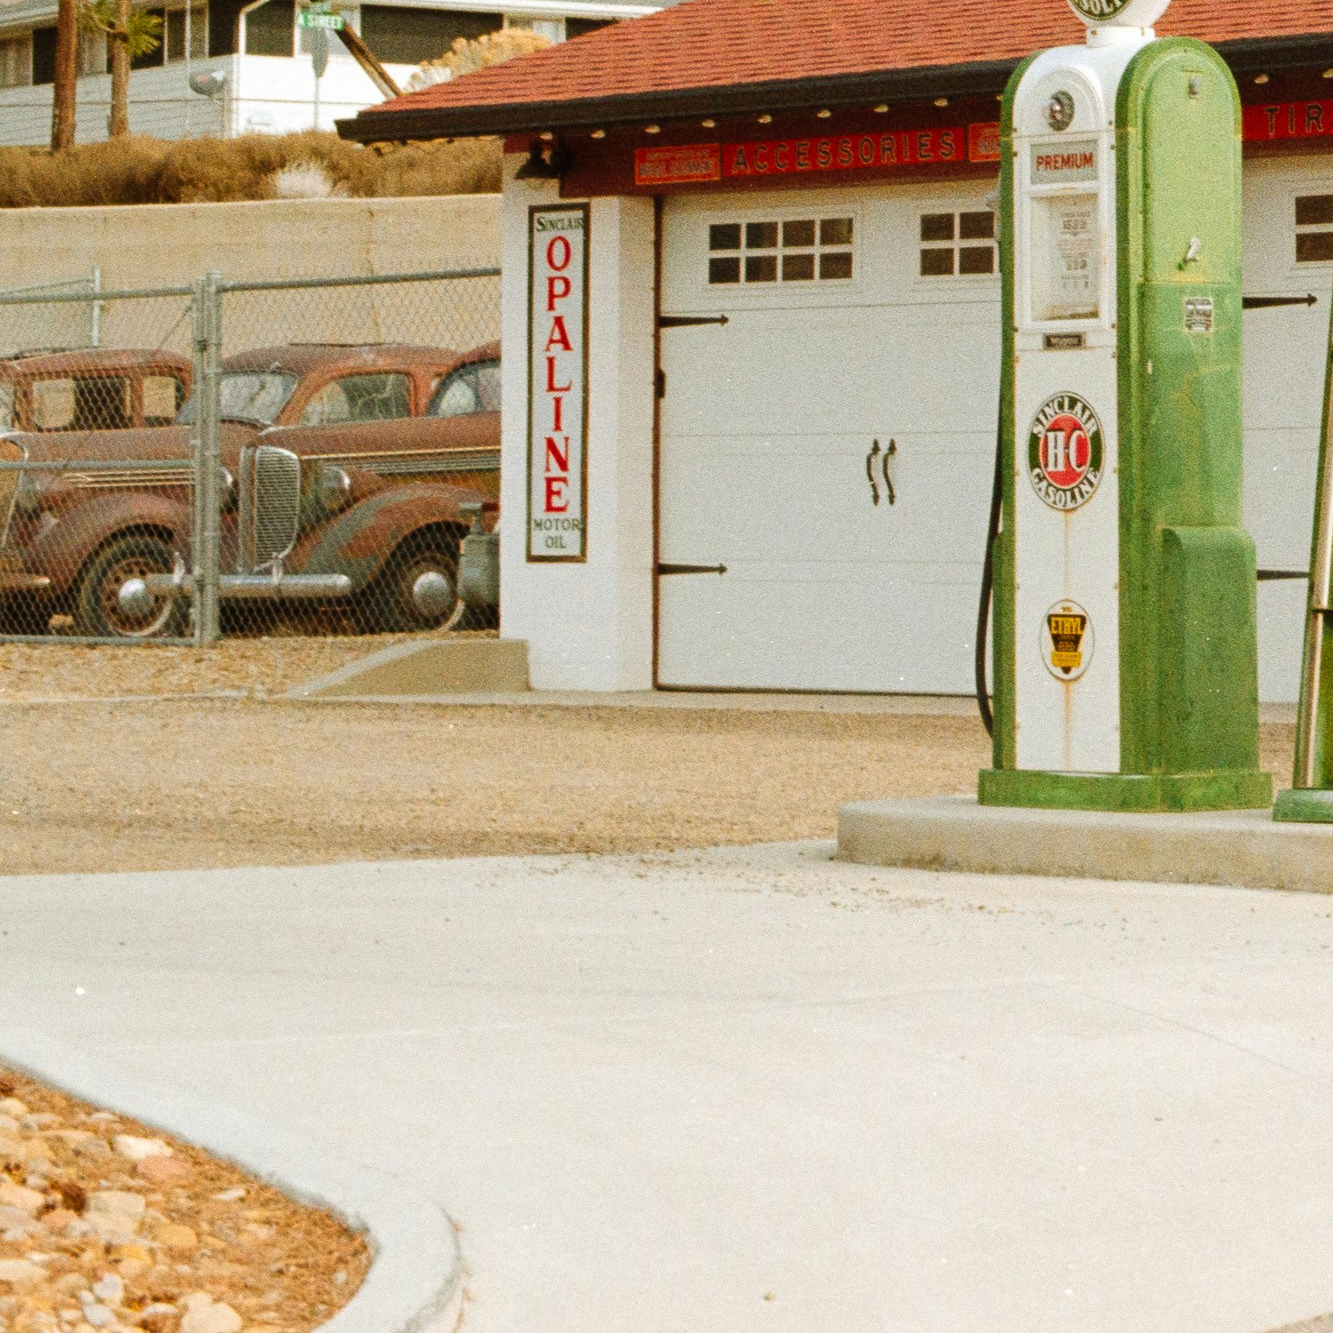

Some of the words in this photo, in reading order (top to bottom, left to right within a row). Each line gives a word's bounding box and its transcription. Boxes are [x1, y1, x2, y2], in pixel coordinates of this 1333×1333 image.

[731, 131, 955, 174] ACCESSORIES
[1036, 152, 1094, 171] PREMIUM
[543, 235, 573, 513] OPALINE
[1032, 396, 1098, 438] SINCLAIR
[1032, 467, 1100, 507] GASOLINE
[533, 518, 583, 531] MOTOR
[545, 536, 567, 548] OIL
[1051, 617, 1083, 635] ETHYL
